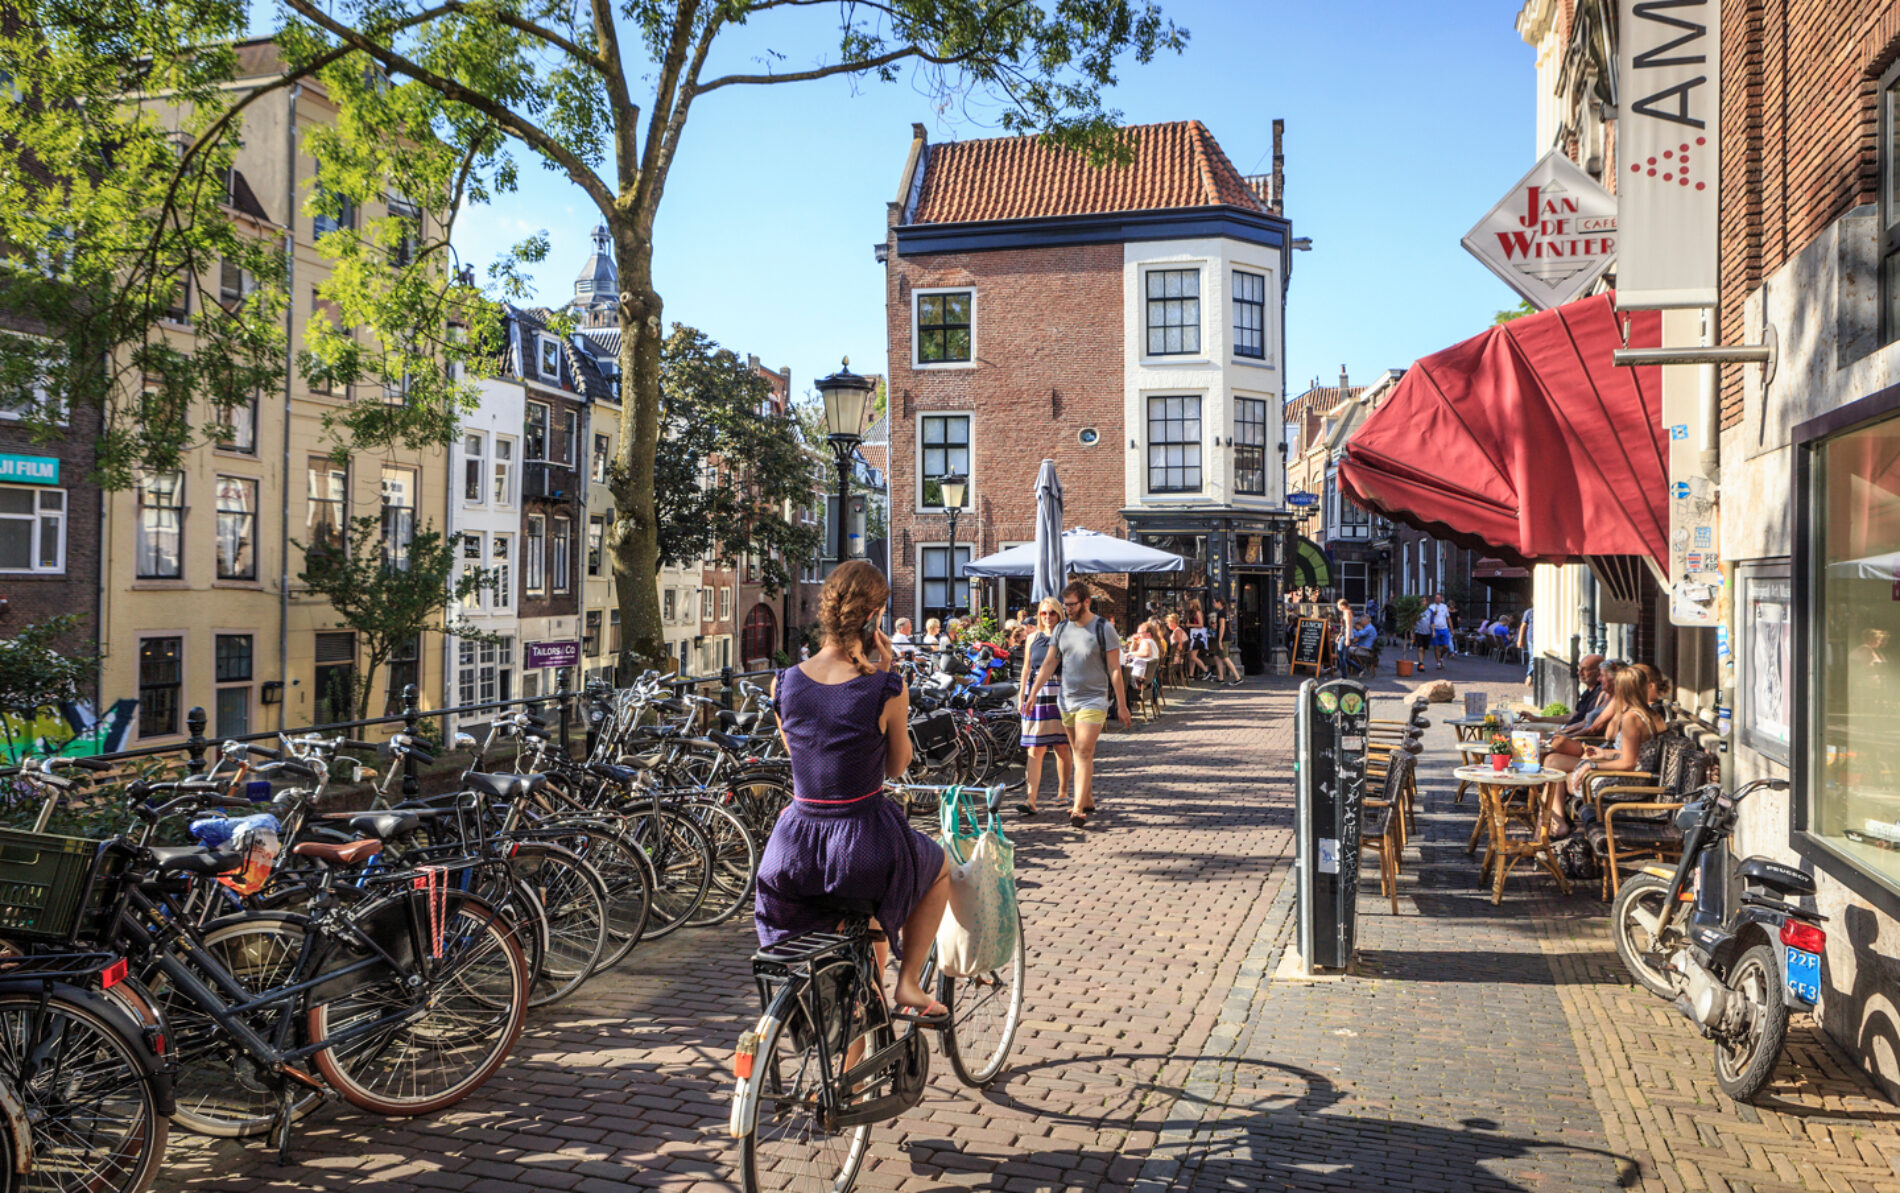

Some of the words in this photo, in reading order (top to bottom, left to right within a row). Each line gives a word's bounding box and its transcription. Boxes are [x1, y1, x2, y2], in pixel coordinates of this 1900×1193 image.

[1519, 186, 1579, 228] JAN
[1541, 218, 1571, 236] DE
[1584, 217, 1617, 229] CAFÉ
[1494, 230, 1616, 261] WINTER
[16, 461, 54, 477] FILM
[533, 646, 561, 656] TAILORS
[1766, 865, 1809, 882] PEUGEOT
[1789, 951, 1816, 968] 22F
